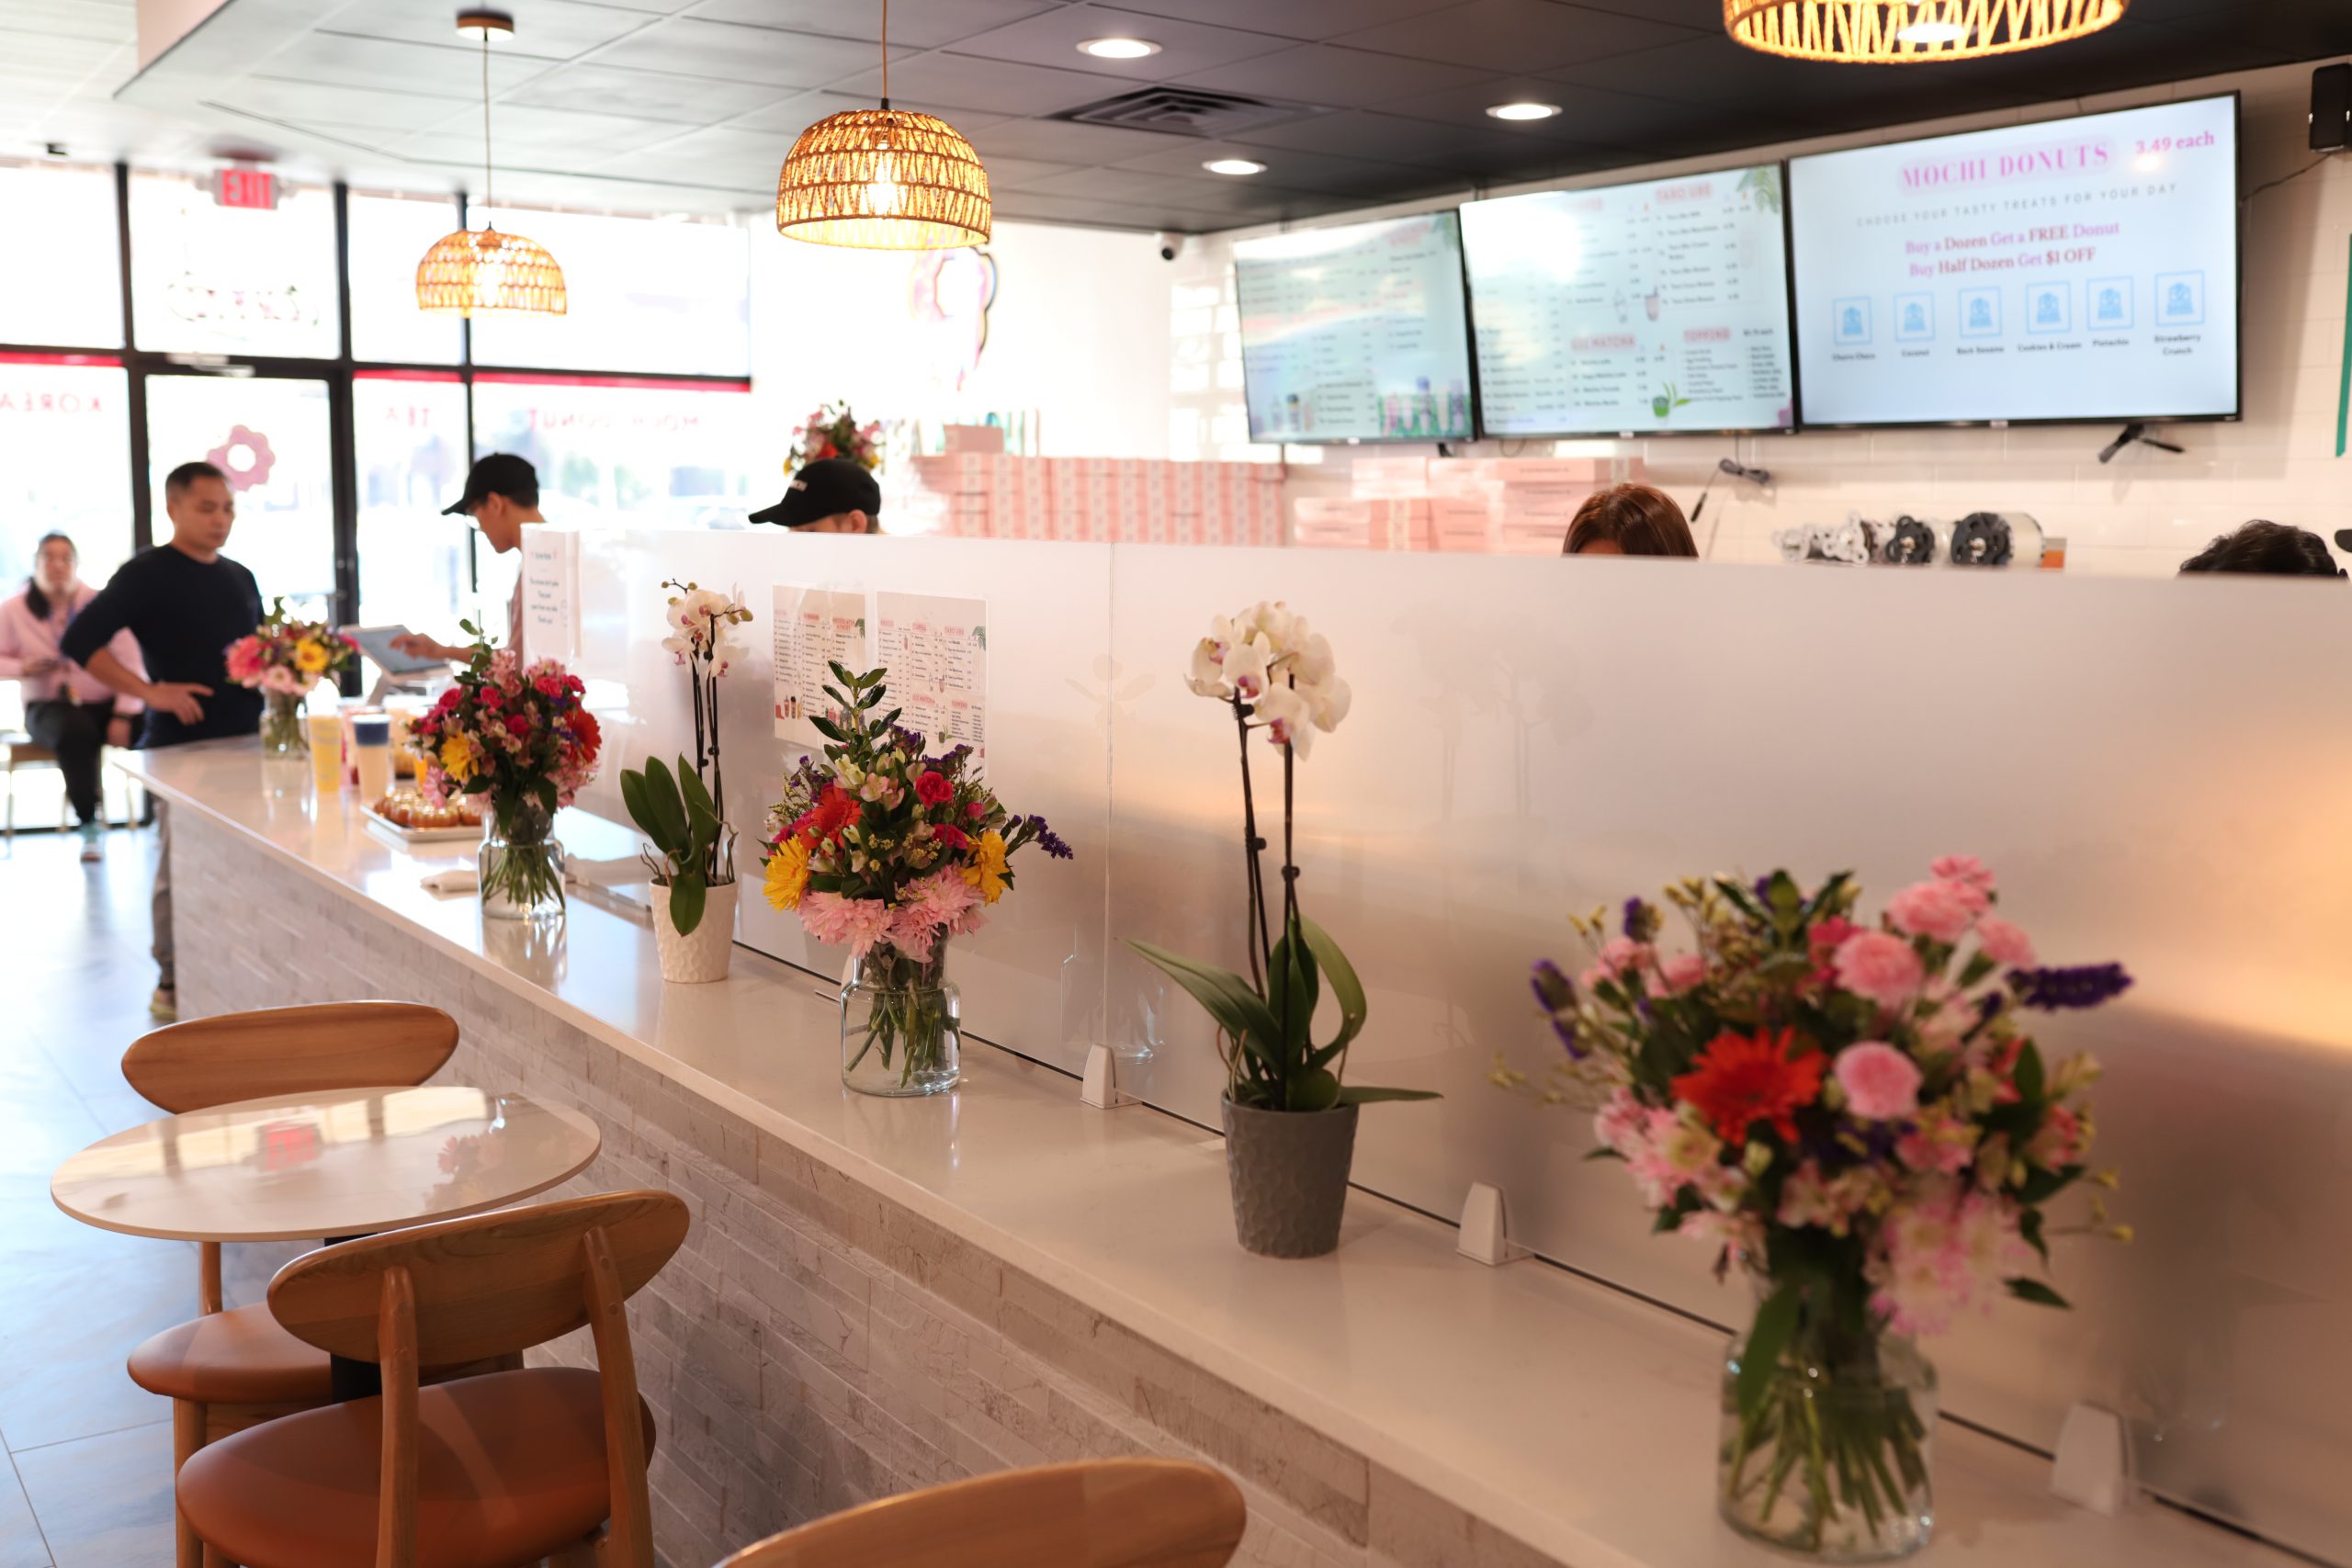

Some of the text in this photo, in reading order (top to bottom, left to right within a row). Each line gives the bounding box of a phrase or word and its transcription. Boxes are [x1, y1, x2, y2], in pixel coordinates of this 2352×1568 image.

[2135, 130, 2216, 155] 3.49 each
[1902, 143, 2109, 188] MOCHI DONUTS
[1856, 183, 2177, 228] CHOOSE YOUR TASTY TREATS FOR YOUR DAY
[1905, 241, 1930, 255] Buy
[1944, 236, 1987, 251] Dozen
[1991, 231, 2015, 246] Get
[2029, 224, 2069, 242] FREE
[2073, 222, 2120, 239] Donut
[1909, 246, 2097, 278] Buy Half Dozen Get $1 OFF
